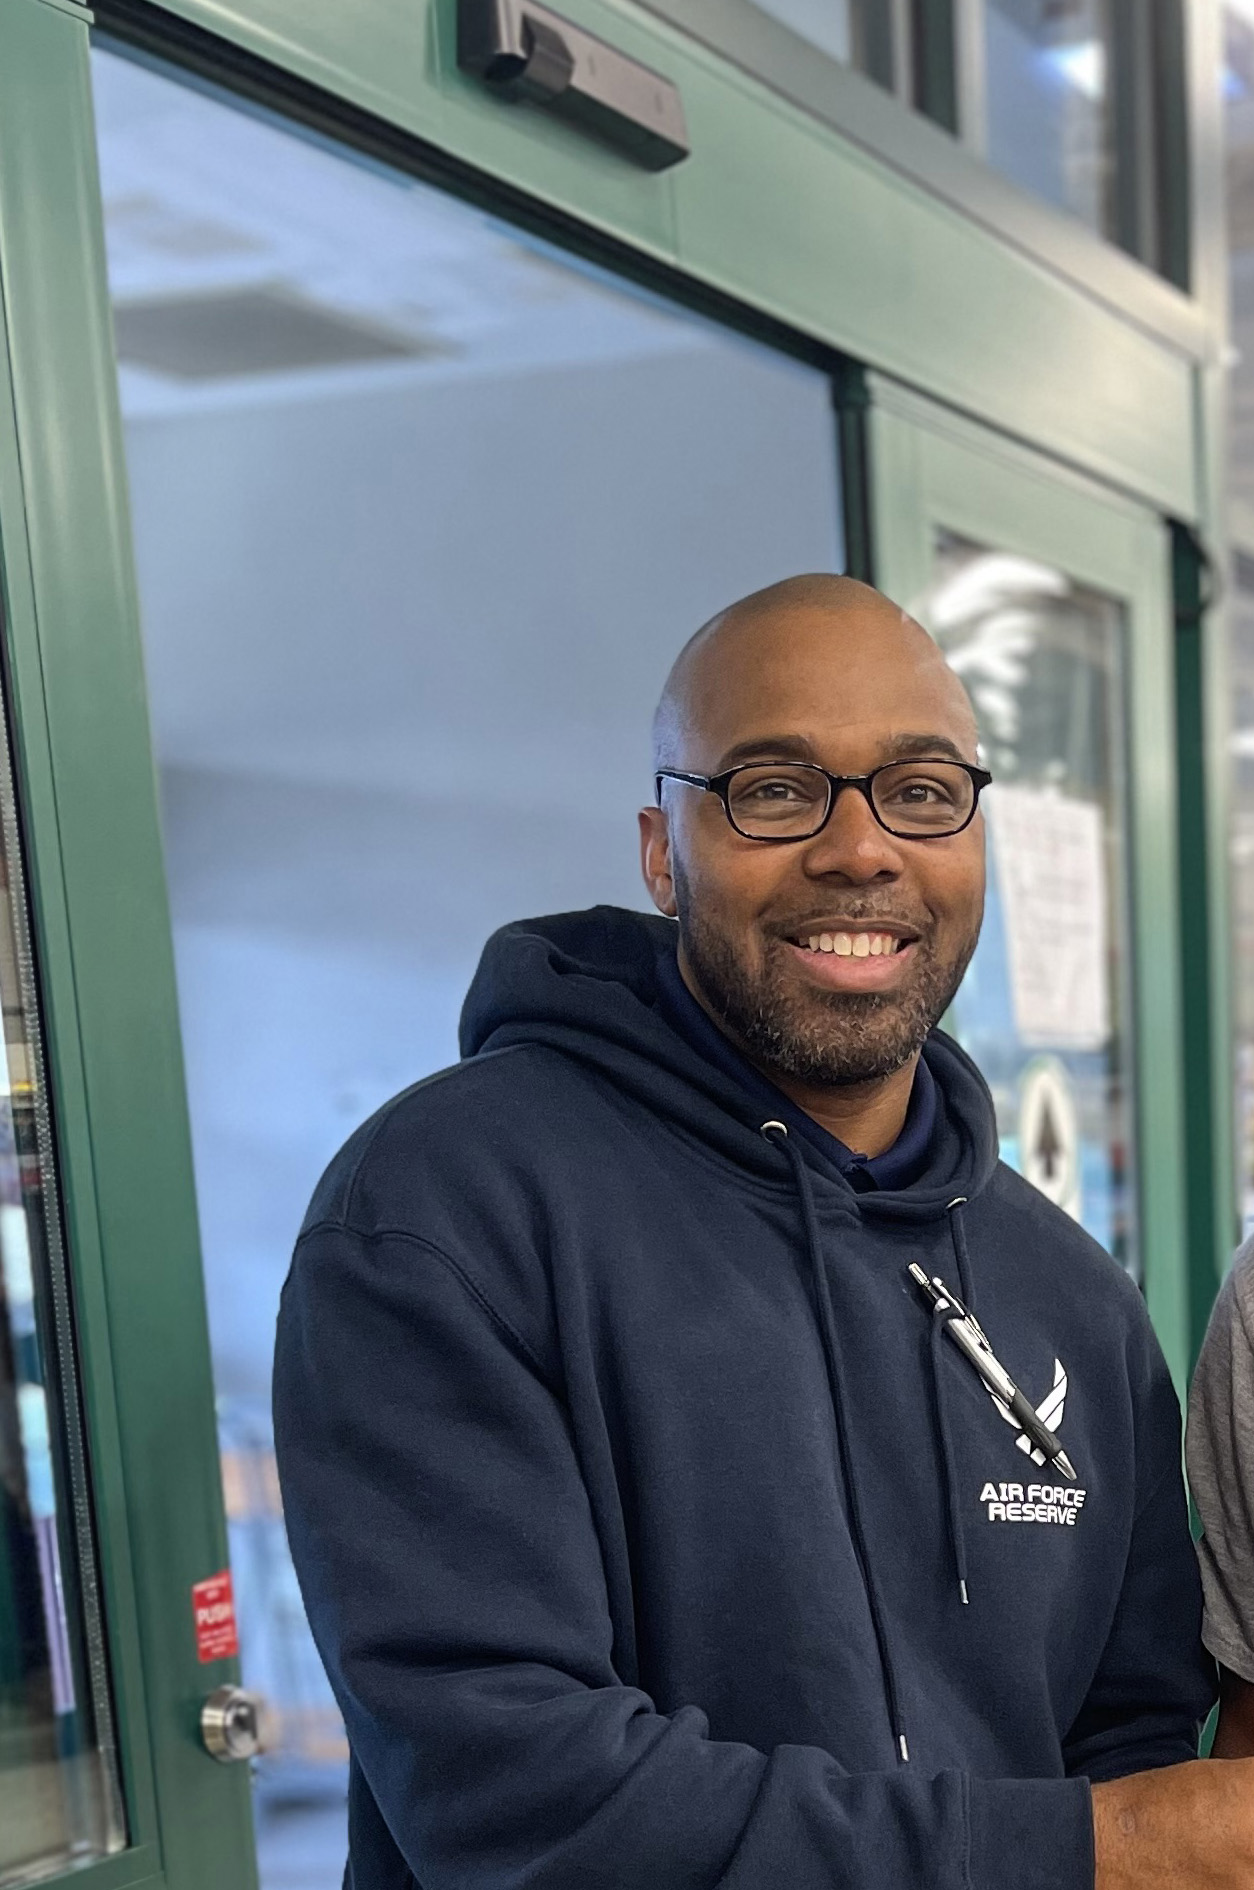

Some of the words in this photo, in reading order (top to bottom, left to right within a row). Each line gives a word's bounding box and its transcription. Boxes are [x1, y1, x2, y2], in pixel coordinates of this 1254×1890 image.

[980, 1482, 1024, 1502] AIR
[1027, 1485, 1086, 1508] FORCE
[988, 1502, 1077, 1525] RESERVE
